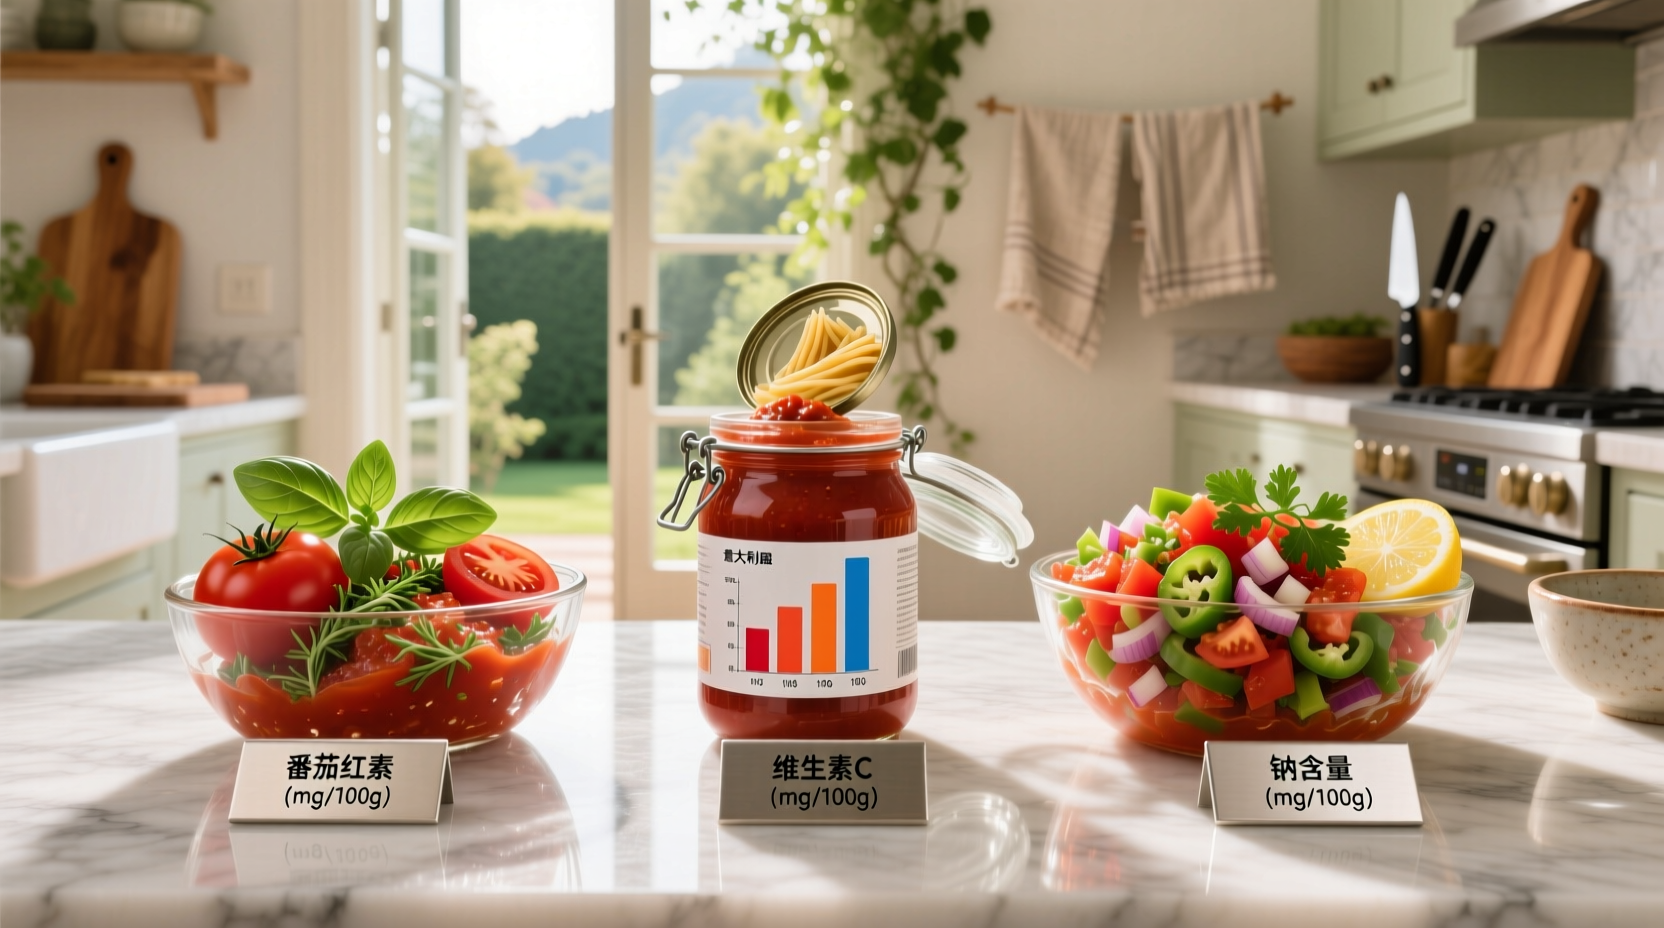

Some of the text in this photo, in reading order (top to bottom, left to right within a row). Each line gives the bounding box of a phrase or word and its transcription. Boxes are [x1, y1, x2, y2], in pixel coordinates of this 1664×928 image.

[287, 752, 394, 780] 番茄红素
[772, 754, 872, 781] 维生素C
[1269, 754, 1353, 781] 钠含量
[284, 785, 391, 810] (mg/100g)
[771, 786, 878, 811] (mg/100g)
[1266, 786, 1373, 811] (mg/100g)
